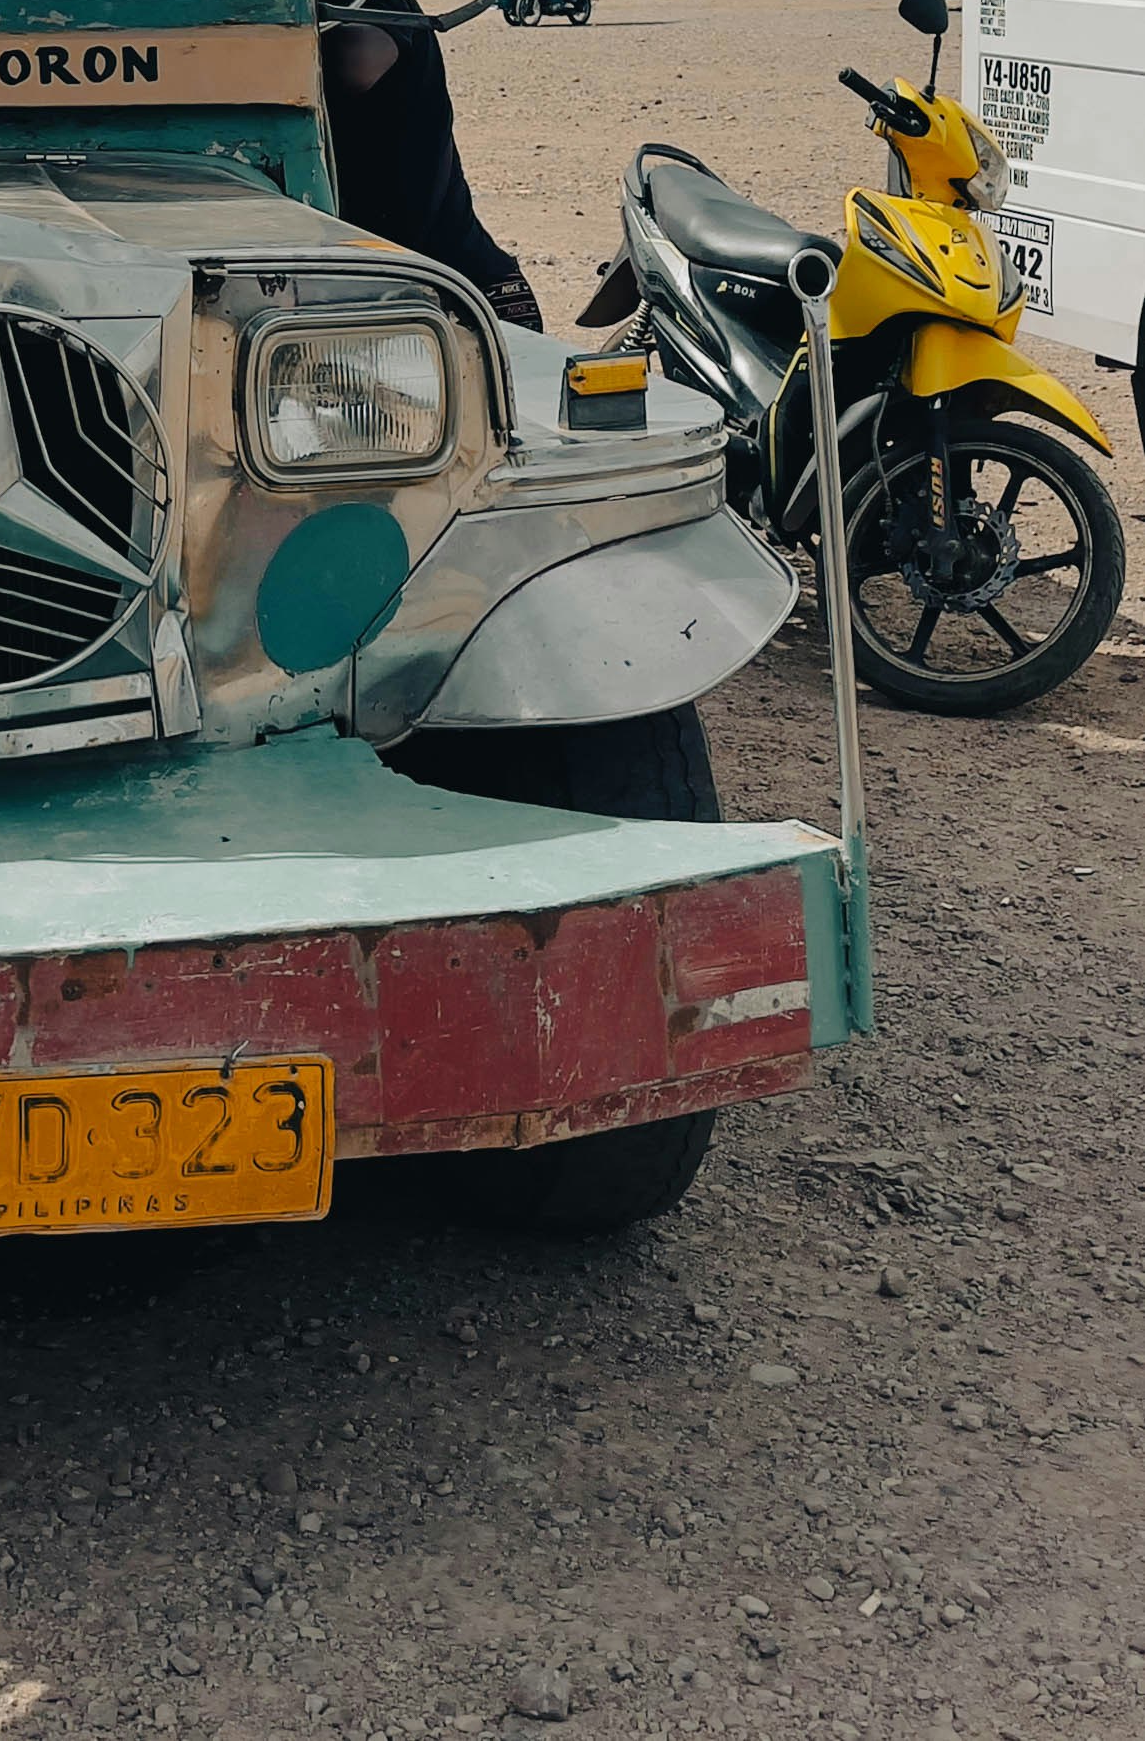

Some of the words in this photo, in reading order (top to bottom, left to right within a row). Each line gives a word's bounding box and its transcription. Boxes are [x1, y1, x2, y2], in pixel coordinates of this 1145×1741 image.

[983, 58, 1051, 95] Y4-U850
[1006, 141, 1033, 162] SERVICE
[111, 1079, 308, 1181] 323
